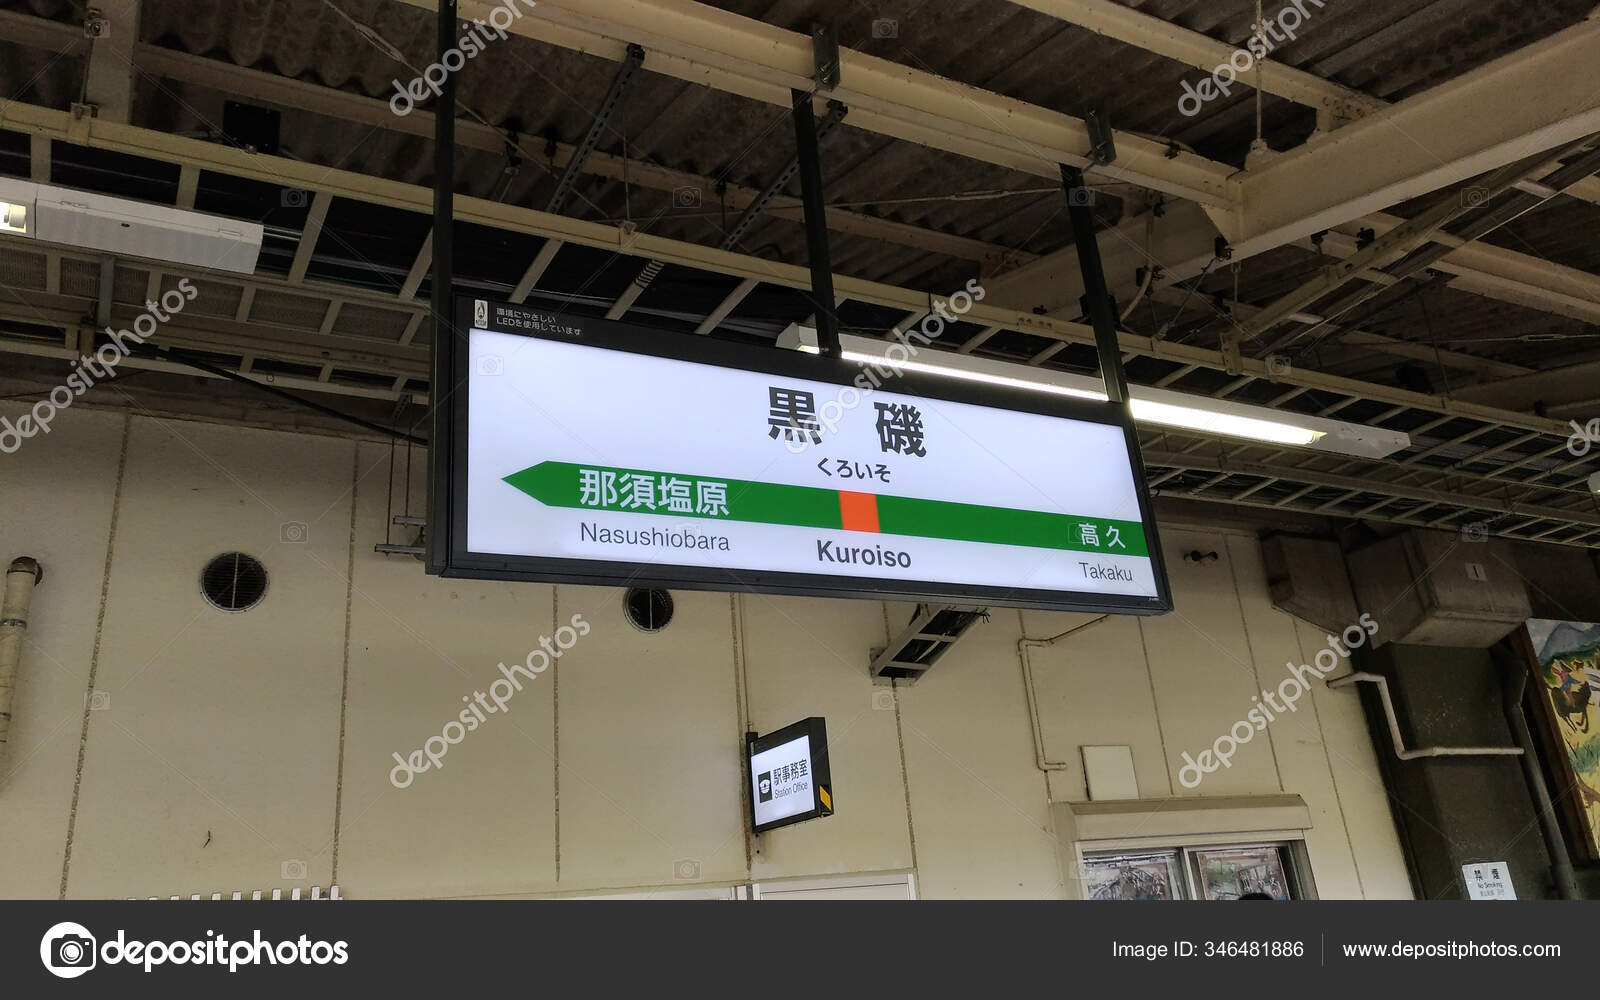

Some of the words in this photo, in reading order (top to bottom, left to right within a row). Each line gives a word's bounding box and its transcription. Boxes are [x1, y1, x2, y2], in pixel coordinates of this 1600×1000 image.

[496, 307, 556, 323] 環境にやさしい
[496, 316, 581, 335] LEDを使用しています
[768, 386, 927, 458] 黒磯
[817, 457, 891, 484] くろいそ
[579, 469, 730, 516] 那須塩原
[581, 522, 730, 551] Nasushiobara
[1079, 523, 1126, 549] 高久
[817, 539, 912, 569] Kuroiso
[1079, 561, 1133, 582] Takaku
[773, 759, 808, 786] 駅事務室
[774, 785, 793, 799] Station
[792, 781, 808, 794] Office
